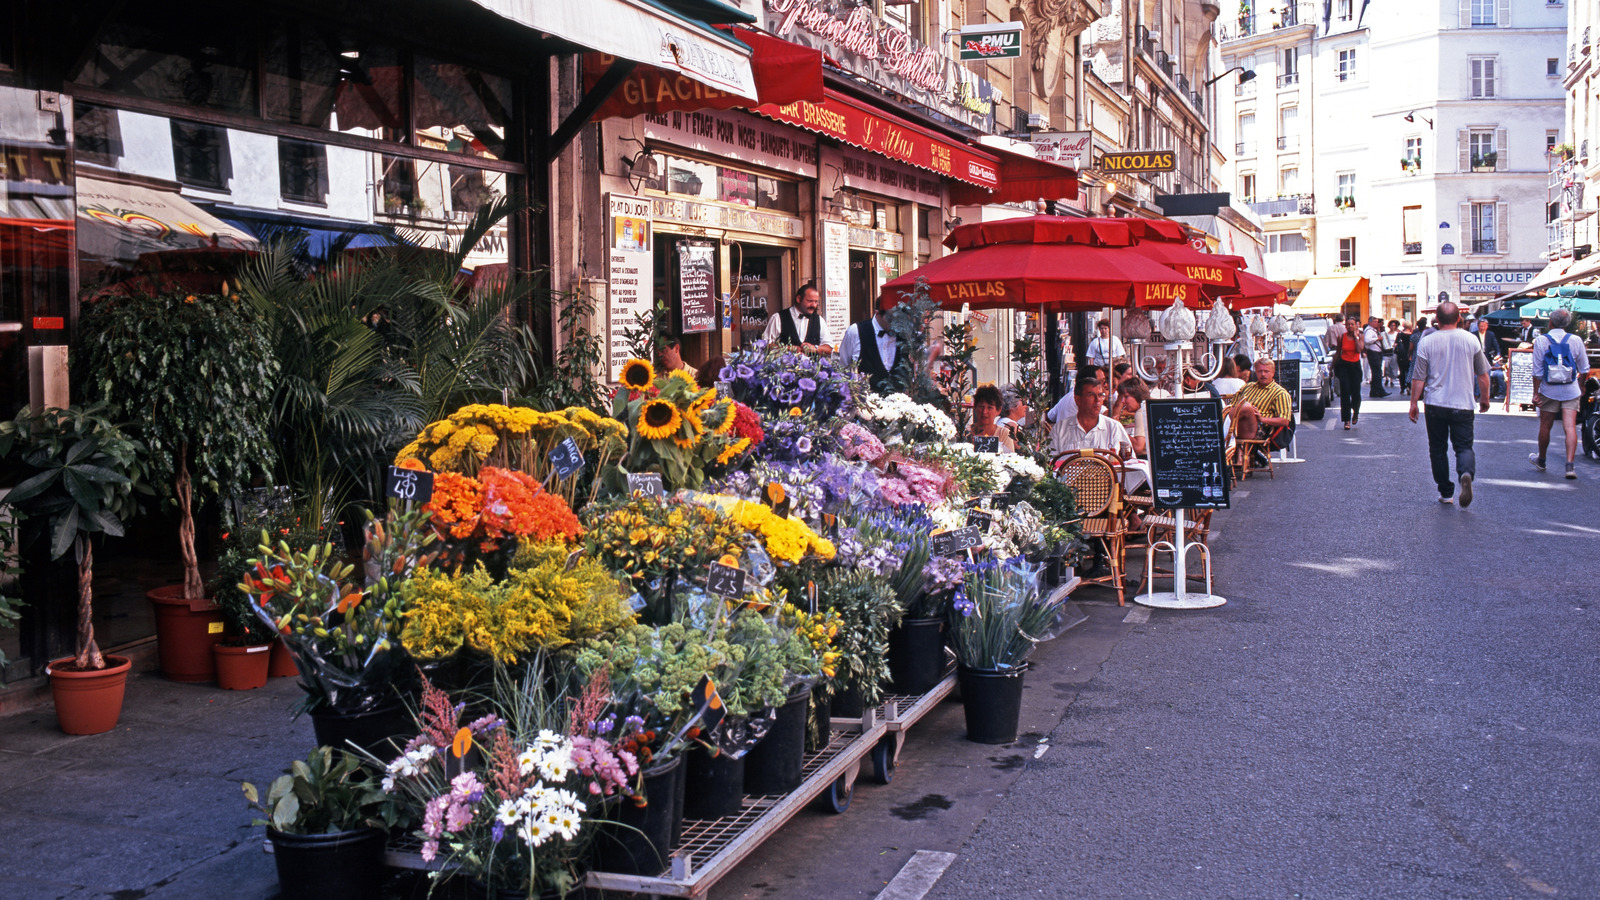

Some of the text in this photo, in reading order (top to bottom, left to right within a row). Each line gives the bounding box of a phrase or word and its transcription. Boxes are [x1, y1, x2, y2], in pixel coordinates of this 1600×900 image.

[981, 34, 1014, 47] PMU
[779, 102, 847, 135] BAR BRASSERIE
[716, 119, 734, 145] POUR
[938, 146, 951, 161] SALLE
[931, 156, 952, 173] AU FOND
[1104, 155, 1172, 170] NICOLAS
[611, 201, 623, 213] PLAT
[625, 203, 633, 214] DU
[635, 205, 648, 216] JOUR
[1187, 267, 1222, 281] L'ATLAS
[945, 281, 1006, 299] L'ATLAS
[1145, 284, 1187, 300] L'ATLAS
